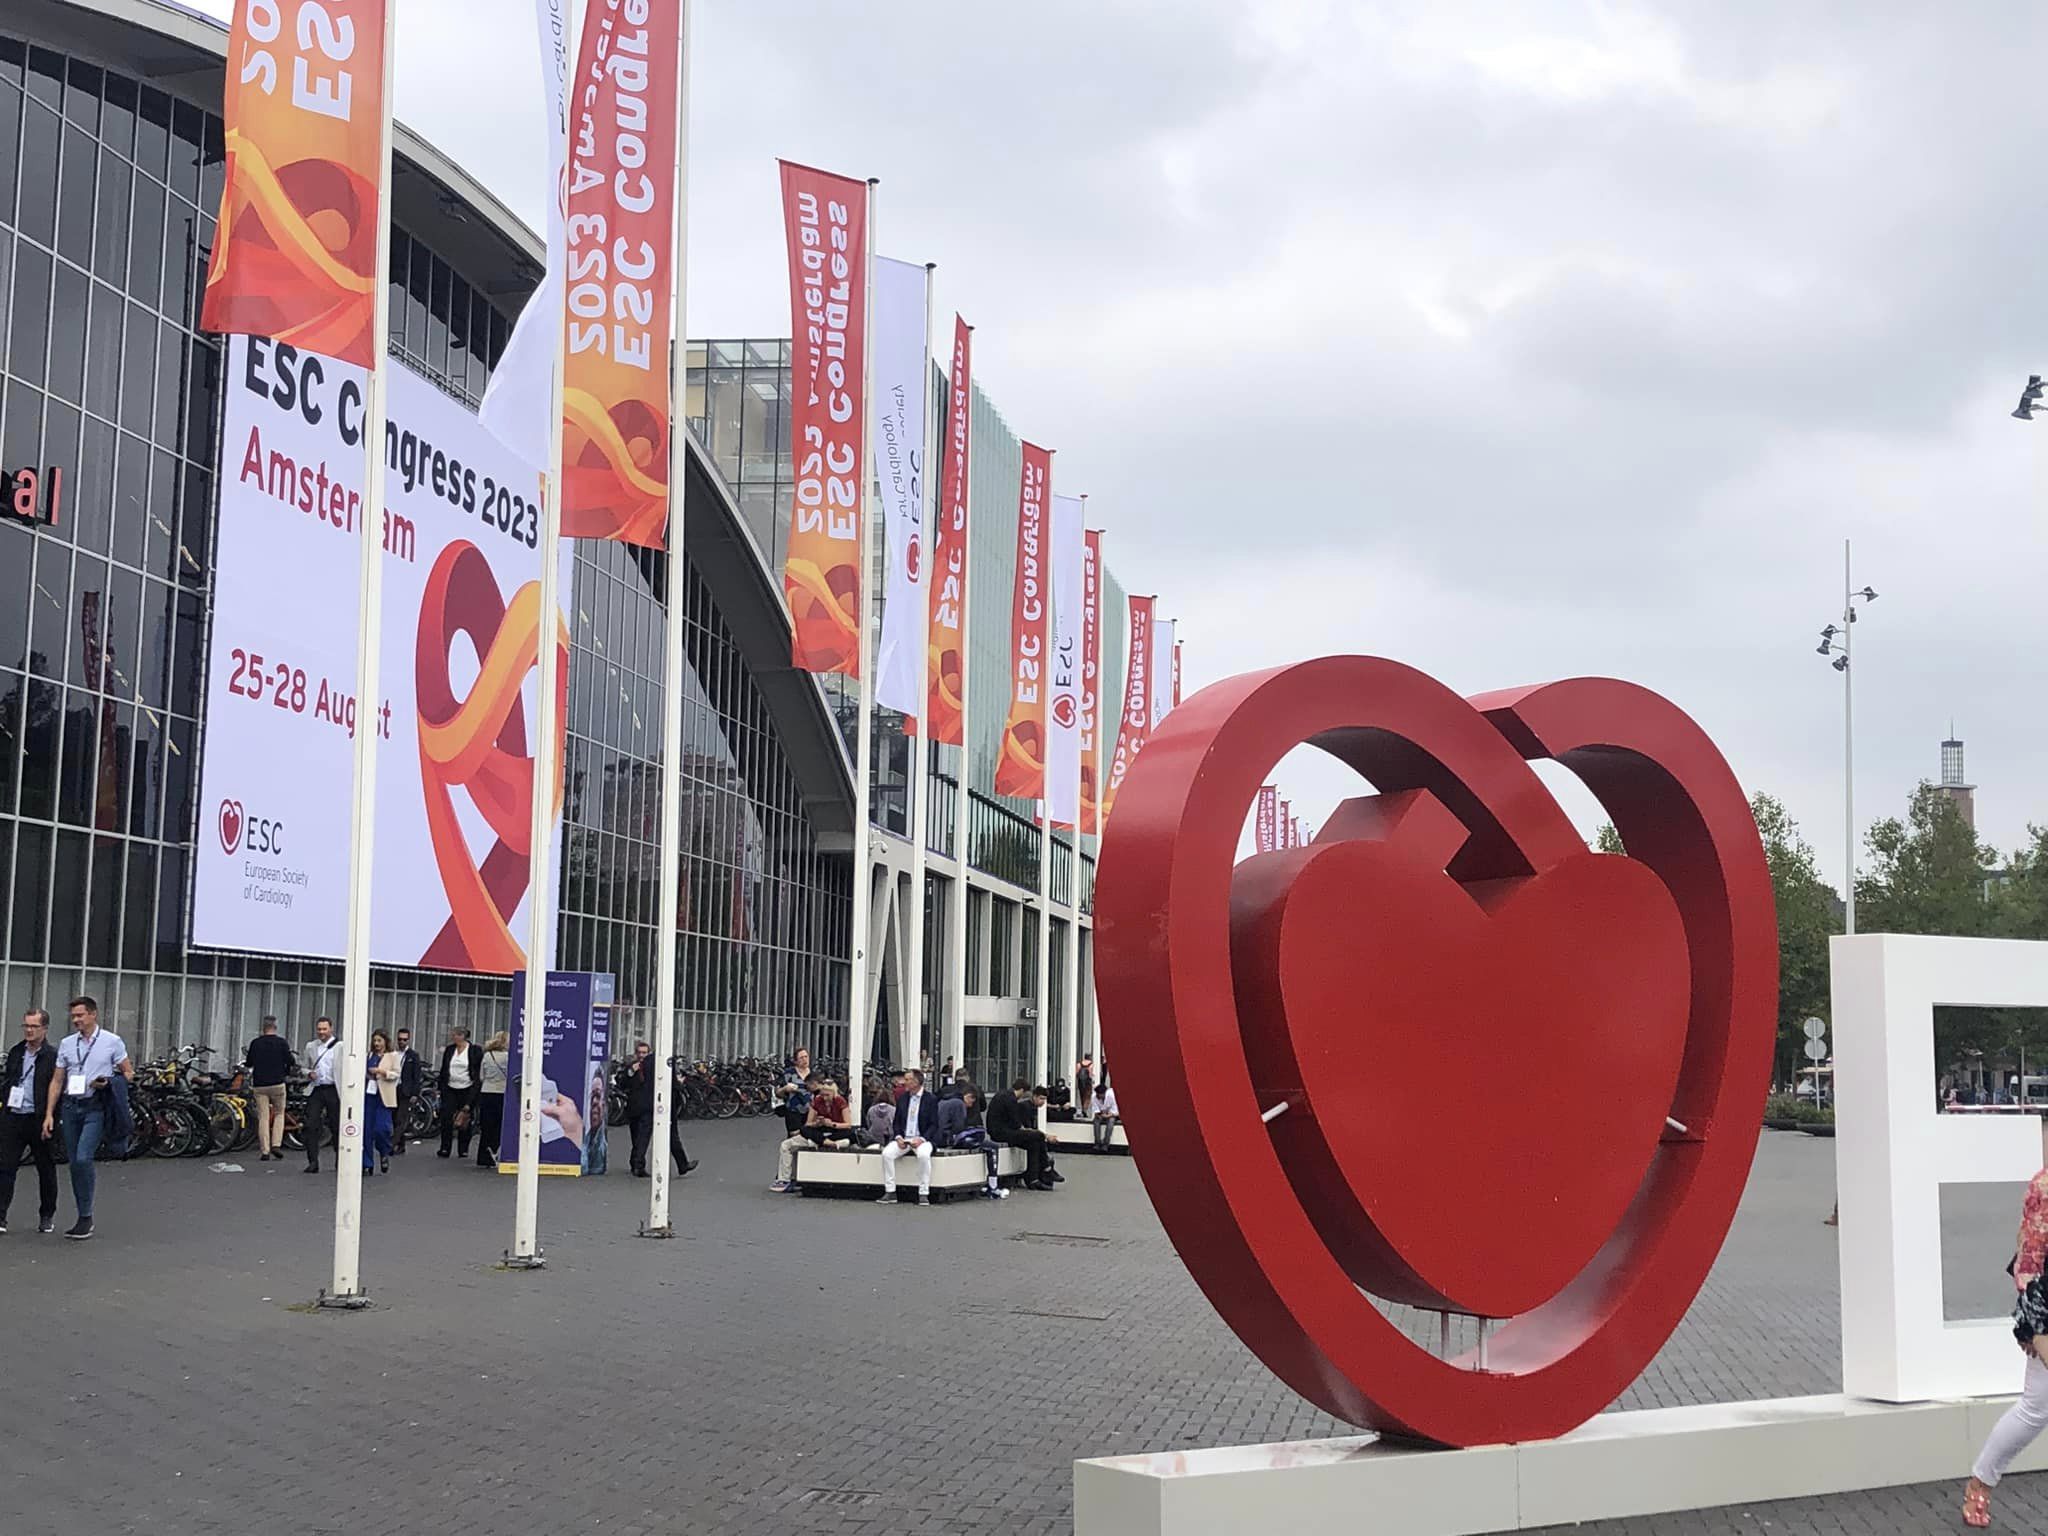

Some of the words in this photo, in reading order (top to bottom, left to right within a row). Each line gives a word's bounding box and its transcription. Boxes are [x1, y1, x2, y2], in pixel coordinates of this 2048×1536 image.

[245, 336, 325, 426] ESC
[338, 379, 477, 515] Cngress
[481, 477, 539, 550] 2023
[12, 467, 62, 526] al
[240, 425, 416, 562] Amsteram
[228, 648, 307, 714] 25-28
[314, 678, 391, 739] Augt
[246, 816, 283, 855] ESC
[244, 884, 253, 899] of
[254, 885, 293, 909] Cardiology
[245, 861, 281, 882] European
[282, 867, 309, 888] Society
[565, 1019, 577, 1028] SL
